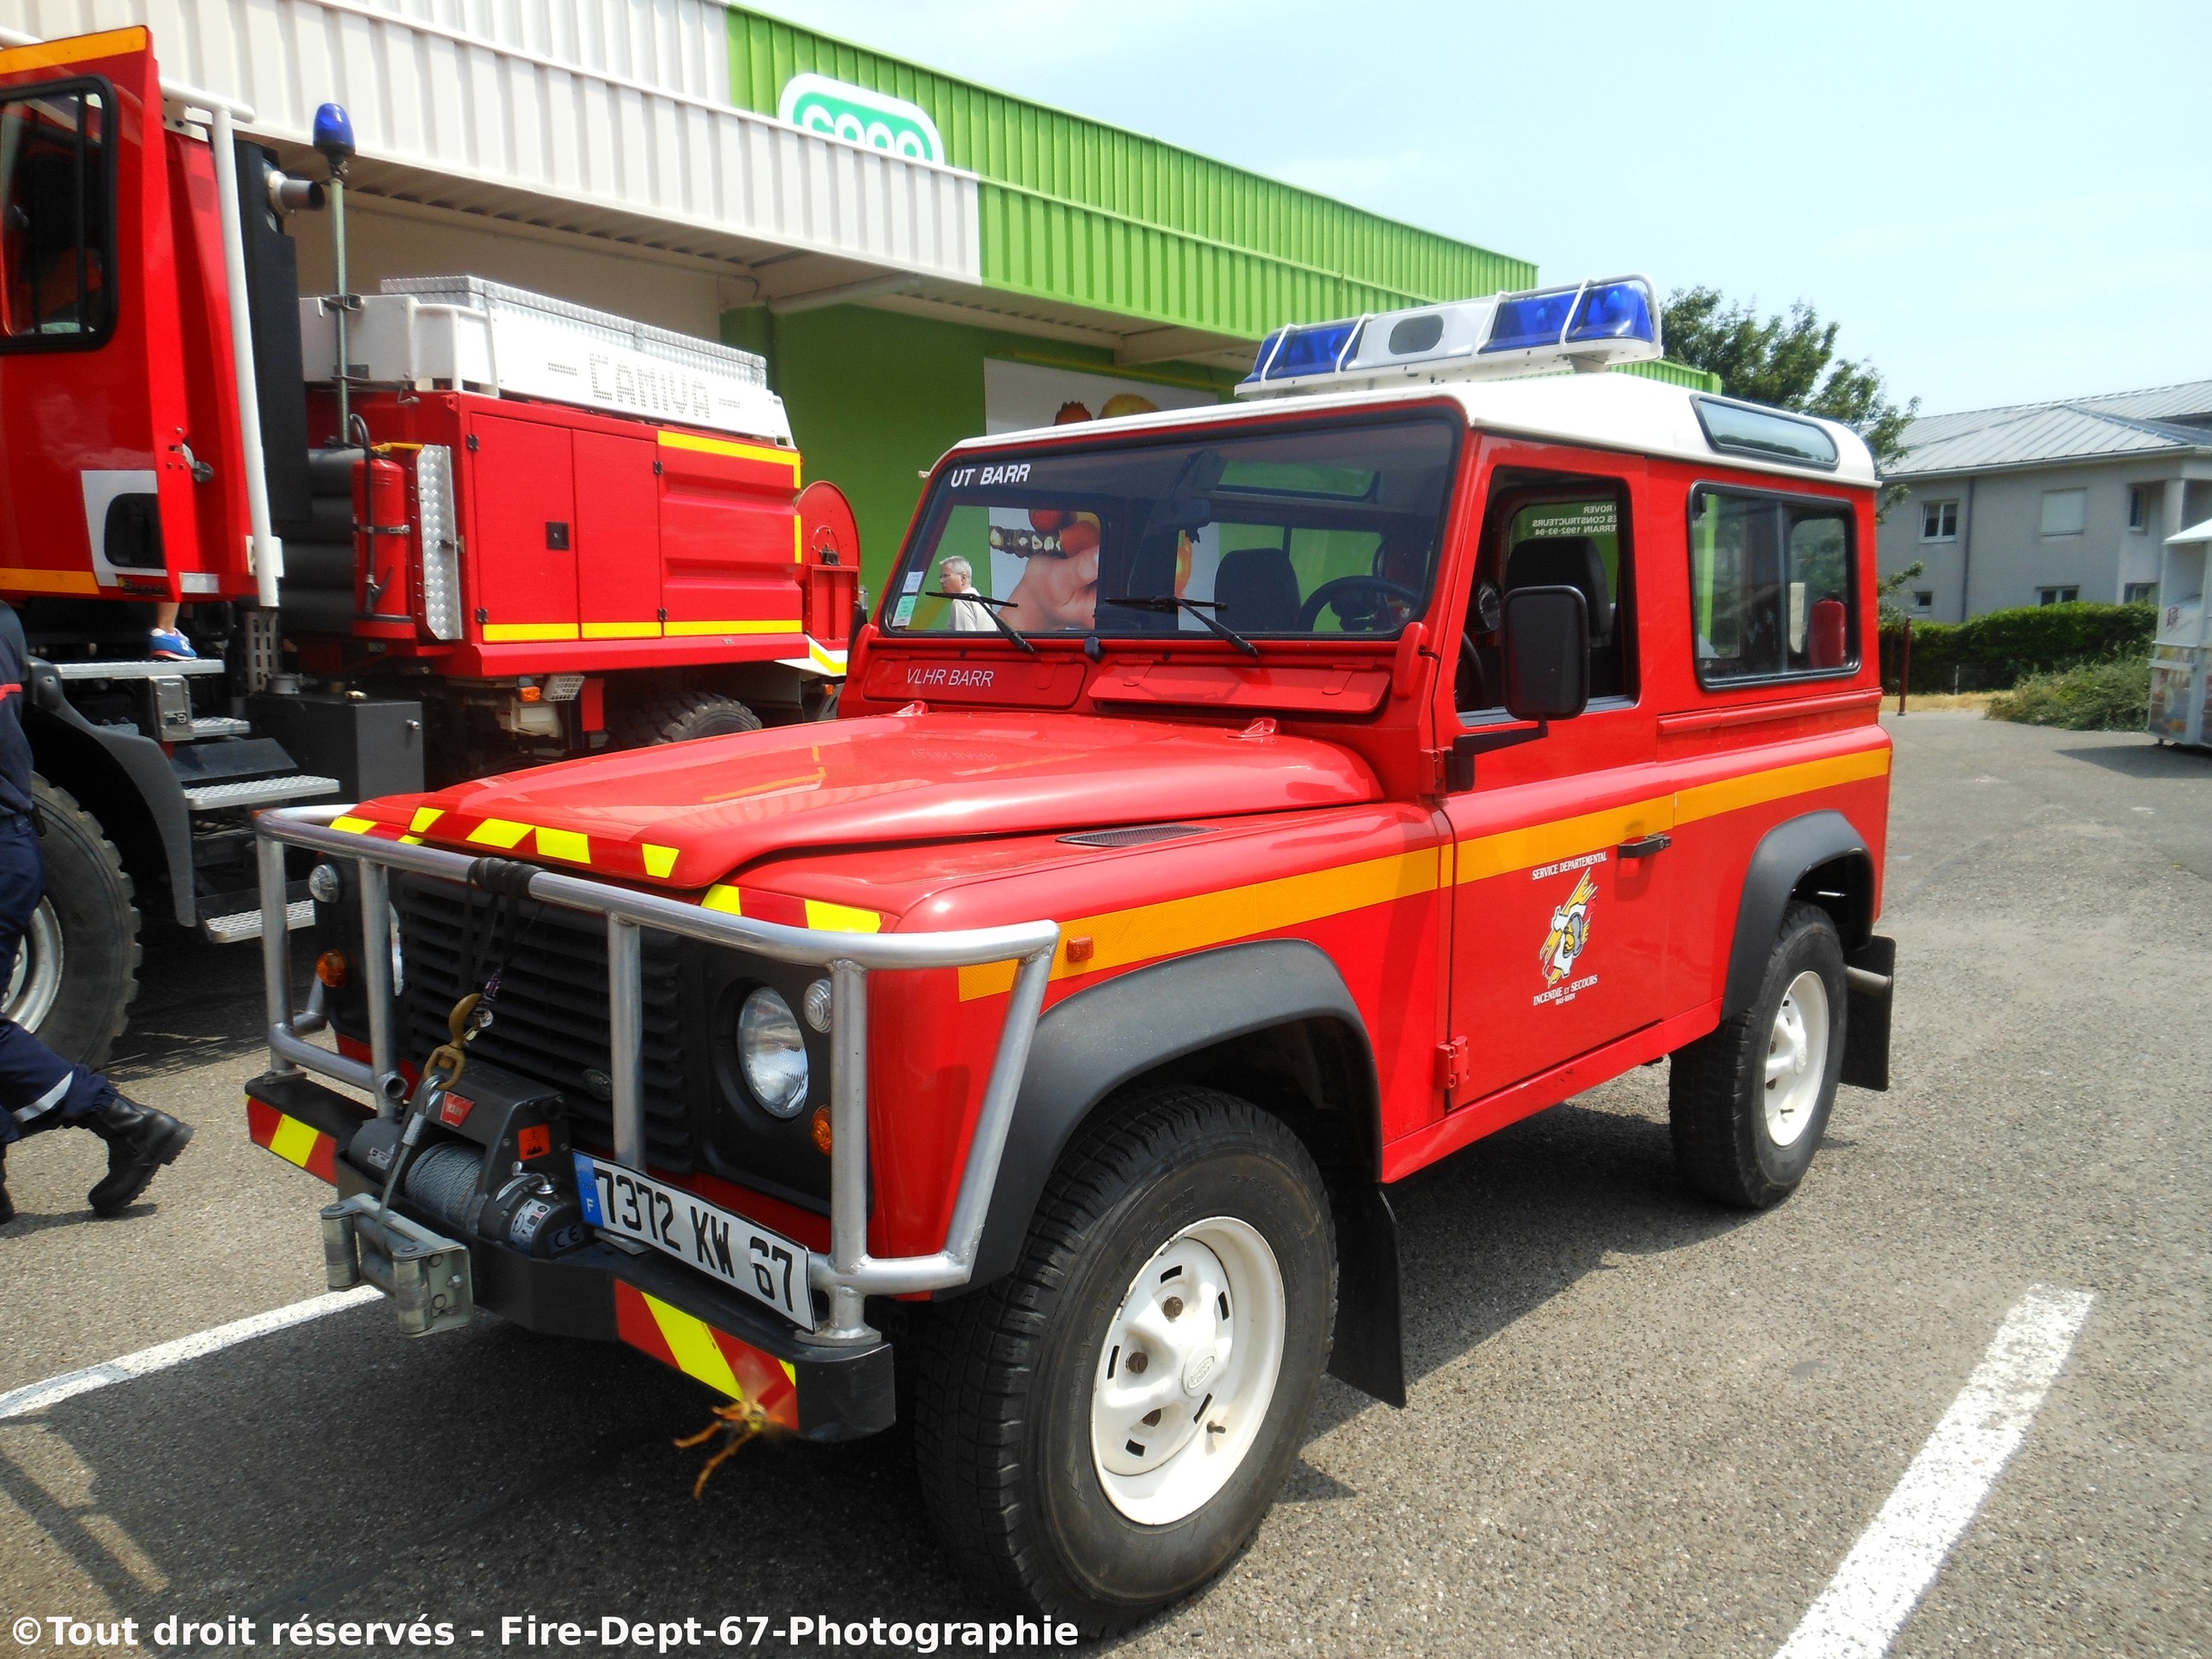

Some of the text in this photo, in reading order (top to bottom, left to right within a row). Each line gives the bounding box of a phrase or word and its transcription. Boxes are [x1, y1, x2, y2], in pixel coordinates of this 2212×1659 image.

[951, 463, 1031, 487] UT BARR
[906, 668, 994, 687] VLHR BARR
[1532, 851, 1608, 881] SERVICE DEPARTEMENTAL
[1533, 987, 1563, 1006] INCENDIE
[1570, 974, 1598, 992] SECOURS
[585, 1198, 594, 1213] F
[595, 1167, 681, 1251] 7372
[749, 1236, 794, 1313] 67
